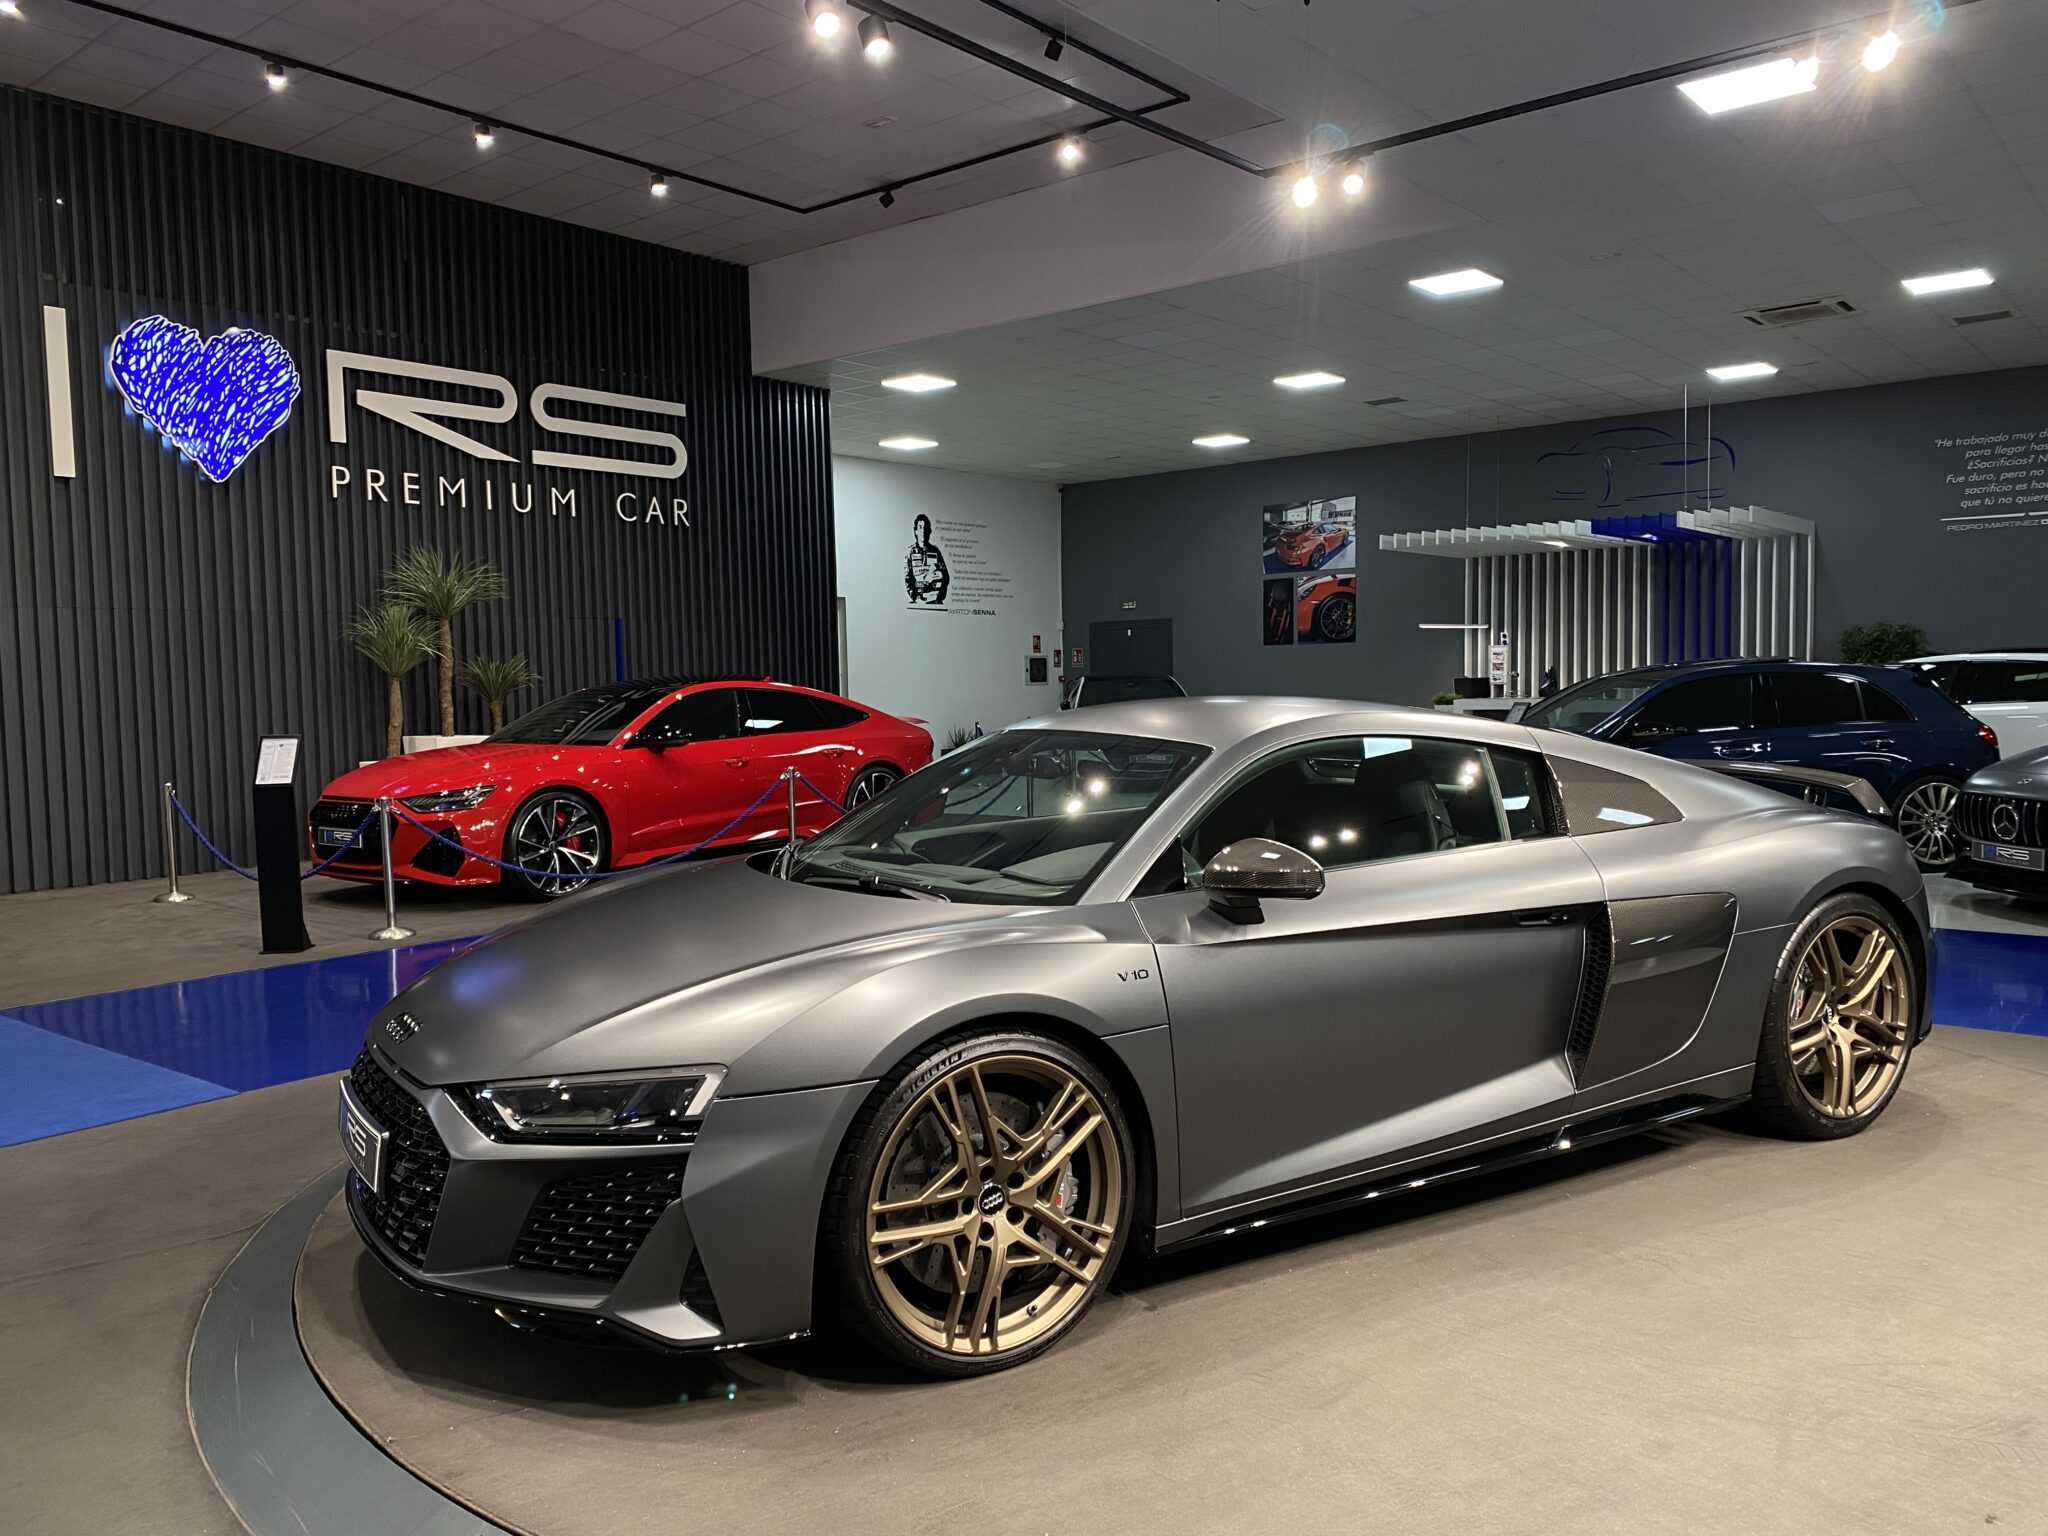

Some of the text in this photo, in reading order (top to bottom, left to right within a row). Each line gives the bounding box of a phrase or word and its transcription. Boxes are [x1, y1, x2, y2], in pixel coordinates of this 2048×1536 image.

[326, 348, 688, 480] RS
[1955, 432, 2009, 447] trabajado
[2011, 430, 2037, 442] muy
[2039, 427, 2048, 438] d
[1964, 448, 1992, 460] para
[1994, 444, 2027, 456] llegar
[1966, 454, 2035, 470] ¿Sacrificios?
[1945, 468, 2045, 484] Fue duro, pero no
[330, 465, 691, 527] PREMIUM CAR
[1963, 482, 2013, 495] sacrificio
[2015, 482, 2028, 492] es
[1960, 498, 1982, 509] que
[1984, 495, 1995, 506] tú
[1998, 496, 2013, 505] no
[1946, 523, 1984, 532] PEDRO
[1984, 519, 2040, 530] MARTINEZ
[1996, 846, 2030, 861] RS
[900, 1049, 963, 1101] MICHELIN
[346, 1111, 367, 1157] RS
